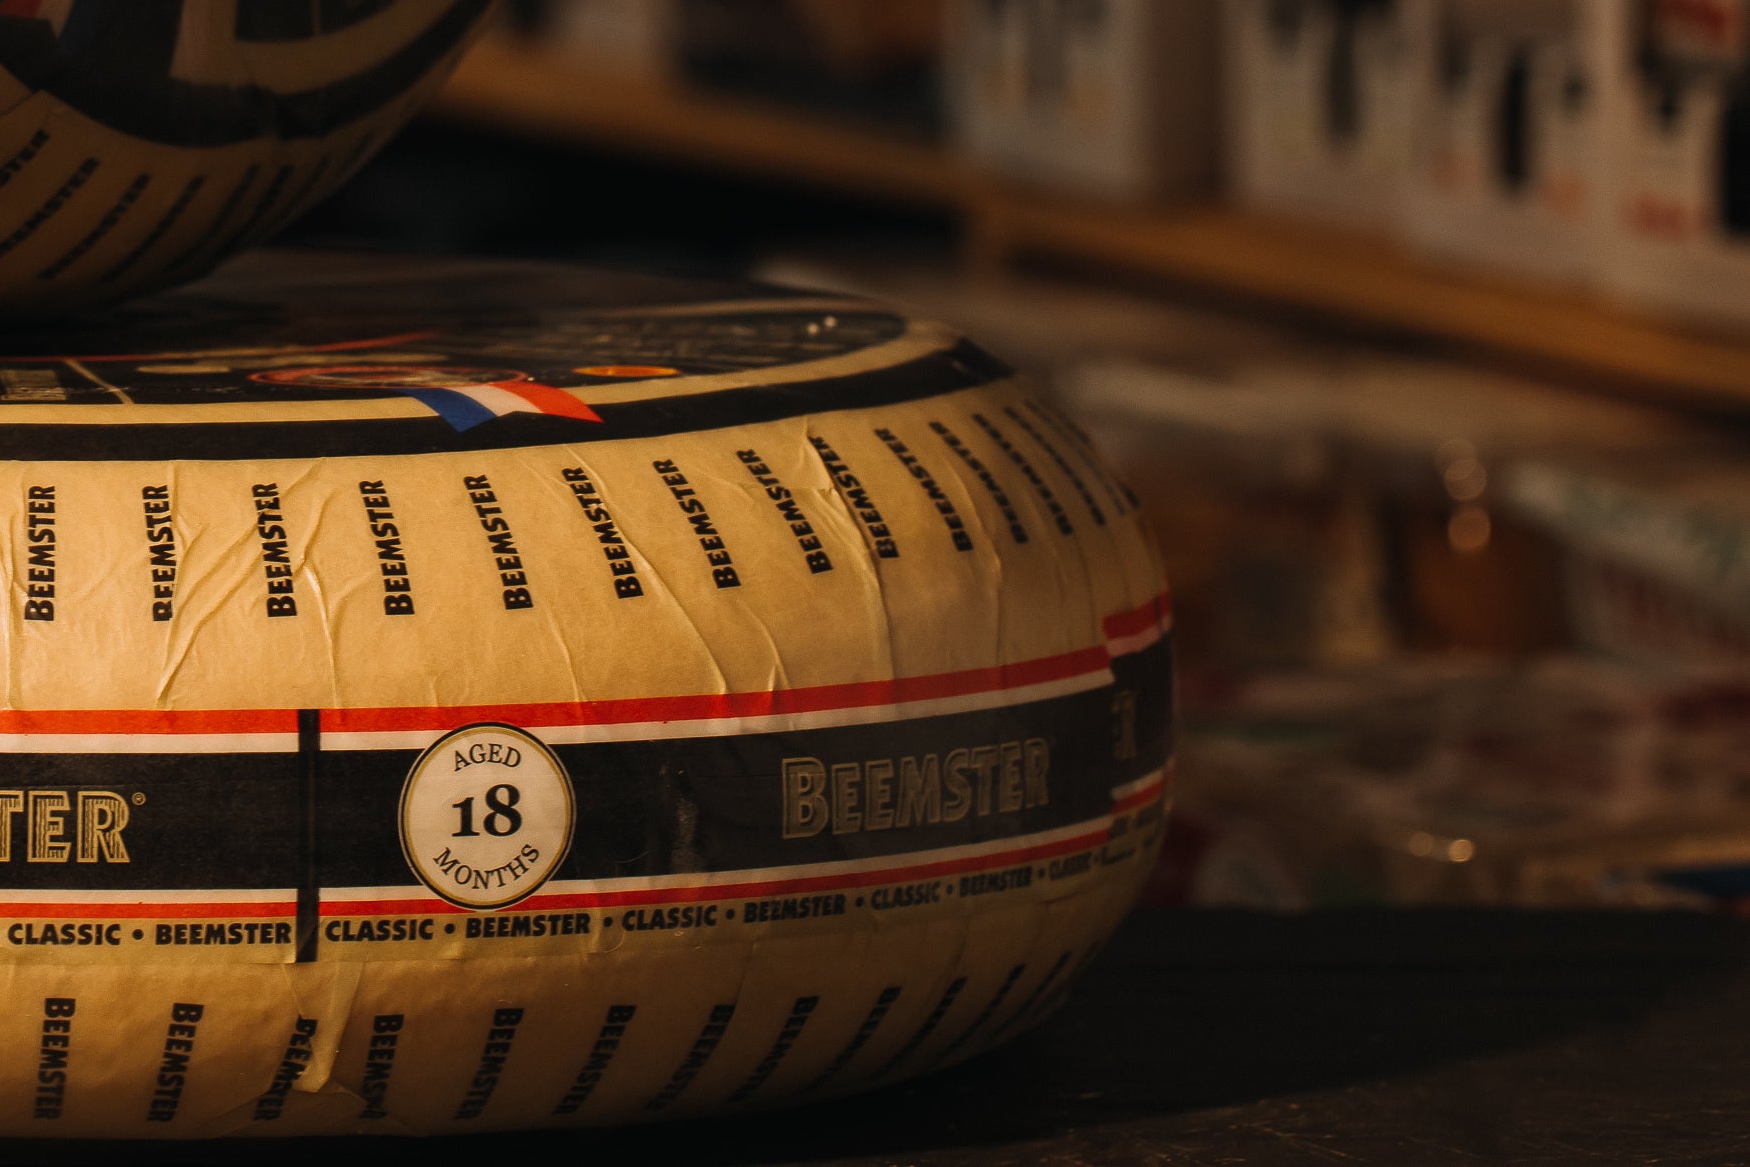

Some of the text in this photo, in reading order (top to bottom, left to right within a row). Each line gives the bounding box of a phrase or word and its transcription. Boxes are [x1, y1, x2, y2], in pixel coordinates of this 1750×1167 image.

[252, 483, 297, 617] BEEMSTER
[359, 479, 415, 616] BEEMSTER
[463, 474, 533, 610] BEEMSTER
[561, 466, 643, 599] BEEMSTER
[653, 458, 741, 589] BEEMSTER
[736, 448, 833, 574] BEEMSTER
[808, 436, 899, 558] BEEMSTER
[874, 428, 973, 552] BEEMSTER
[24, 485, 56, 621] BEEMSTER
[451, 783, 522, 837] 18
[452, 742, 521, 771] AGED
[782, 737, 1049, 839] BEEMSTER
[7, 923, 121, 946] CLASSIC
[155, 922, 291, 945] BEEMSTER
[325, 919, 433, 943] CLASSIC
[465, 913, 590, 939] BEEMSTER
[621, 904, 717, 931] CLASSIC
[743, 894, 846, 924] BEEMSTER
[871, 880, 940, 910] CLASSIC
[433, 844, 540, 891] MONTHS
[34, 997, 75, 1120] BEEMSTER
[147, 1003, 204, 1123] BEEMSTER
[454, 1008, 523, 1119] BEEMSTER
[552, 1005, 636, 1115] BEEMSTER
